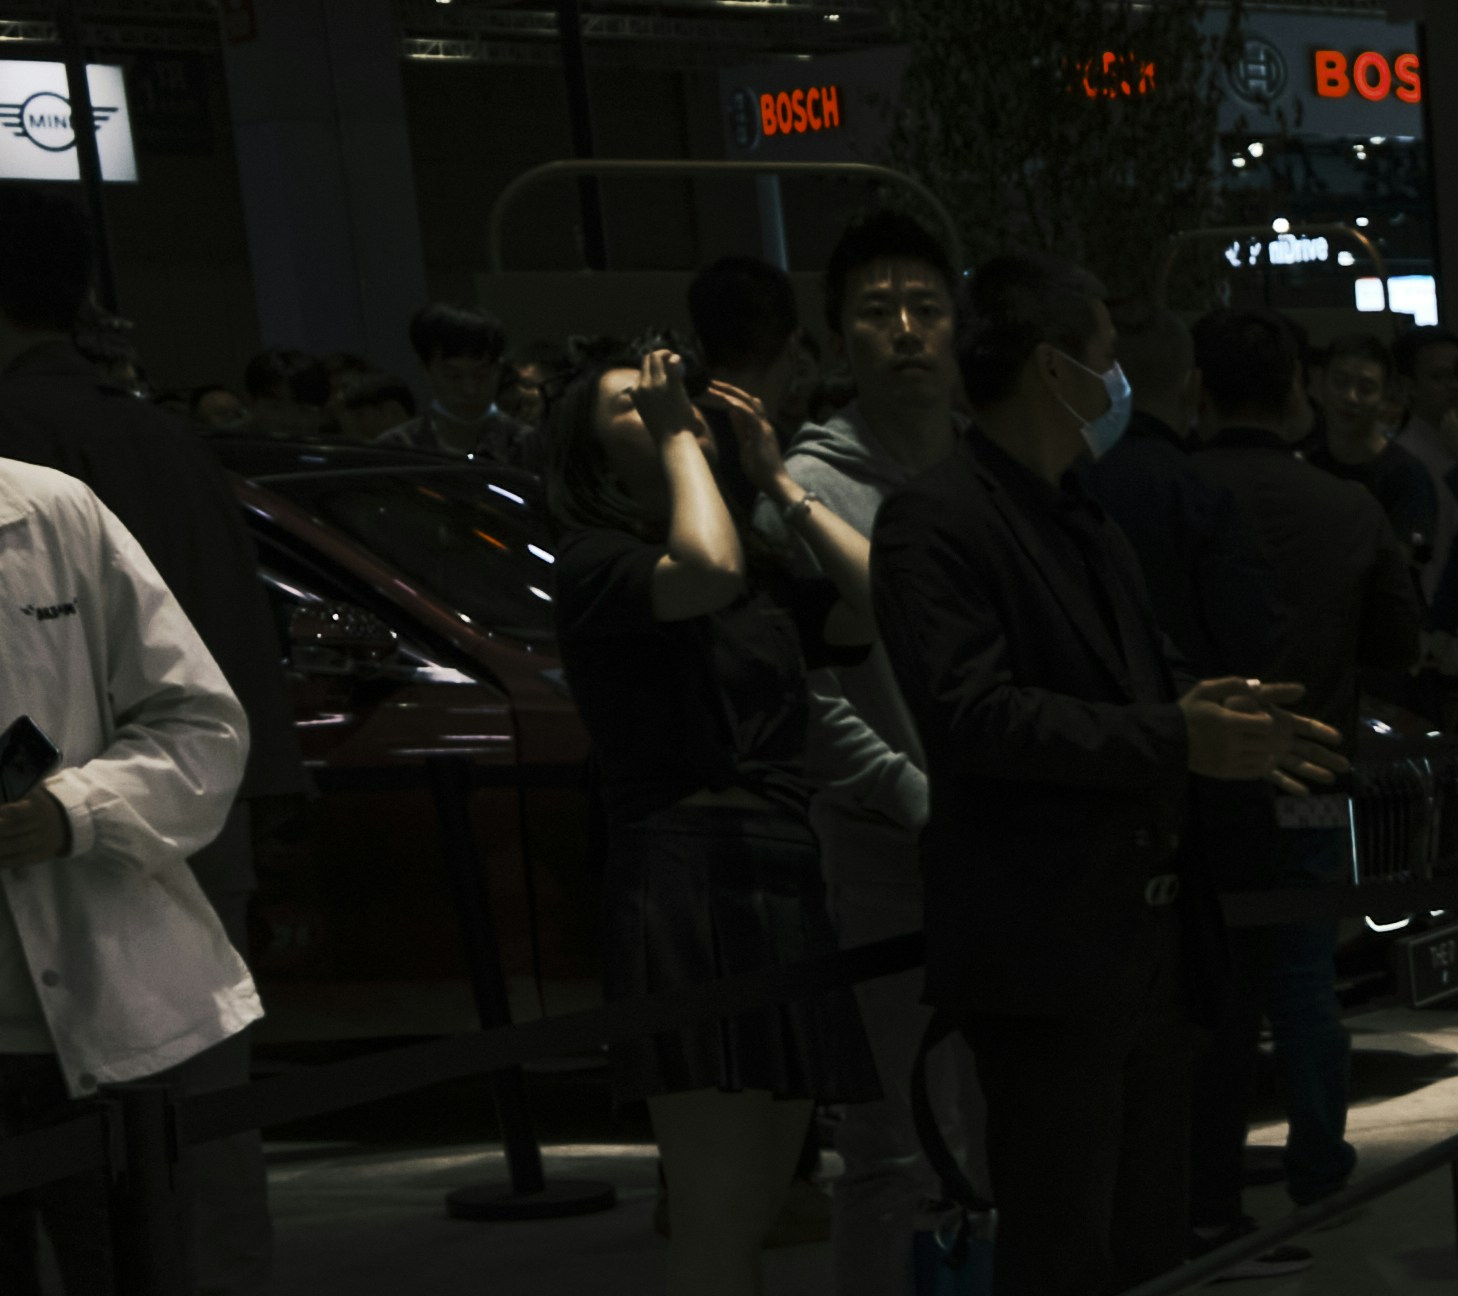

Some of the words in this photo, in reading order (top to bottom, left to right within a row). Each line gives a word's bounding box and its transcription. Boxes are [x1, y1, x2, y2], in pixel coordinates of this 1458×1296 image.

[1315, 50, 1422, 103] BOS
[29, 114, 72, 129] MIN
[760, 85, 840, 136] BOSCH
